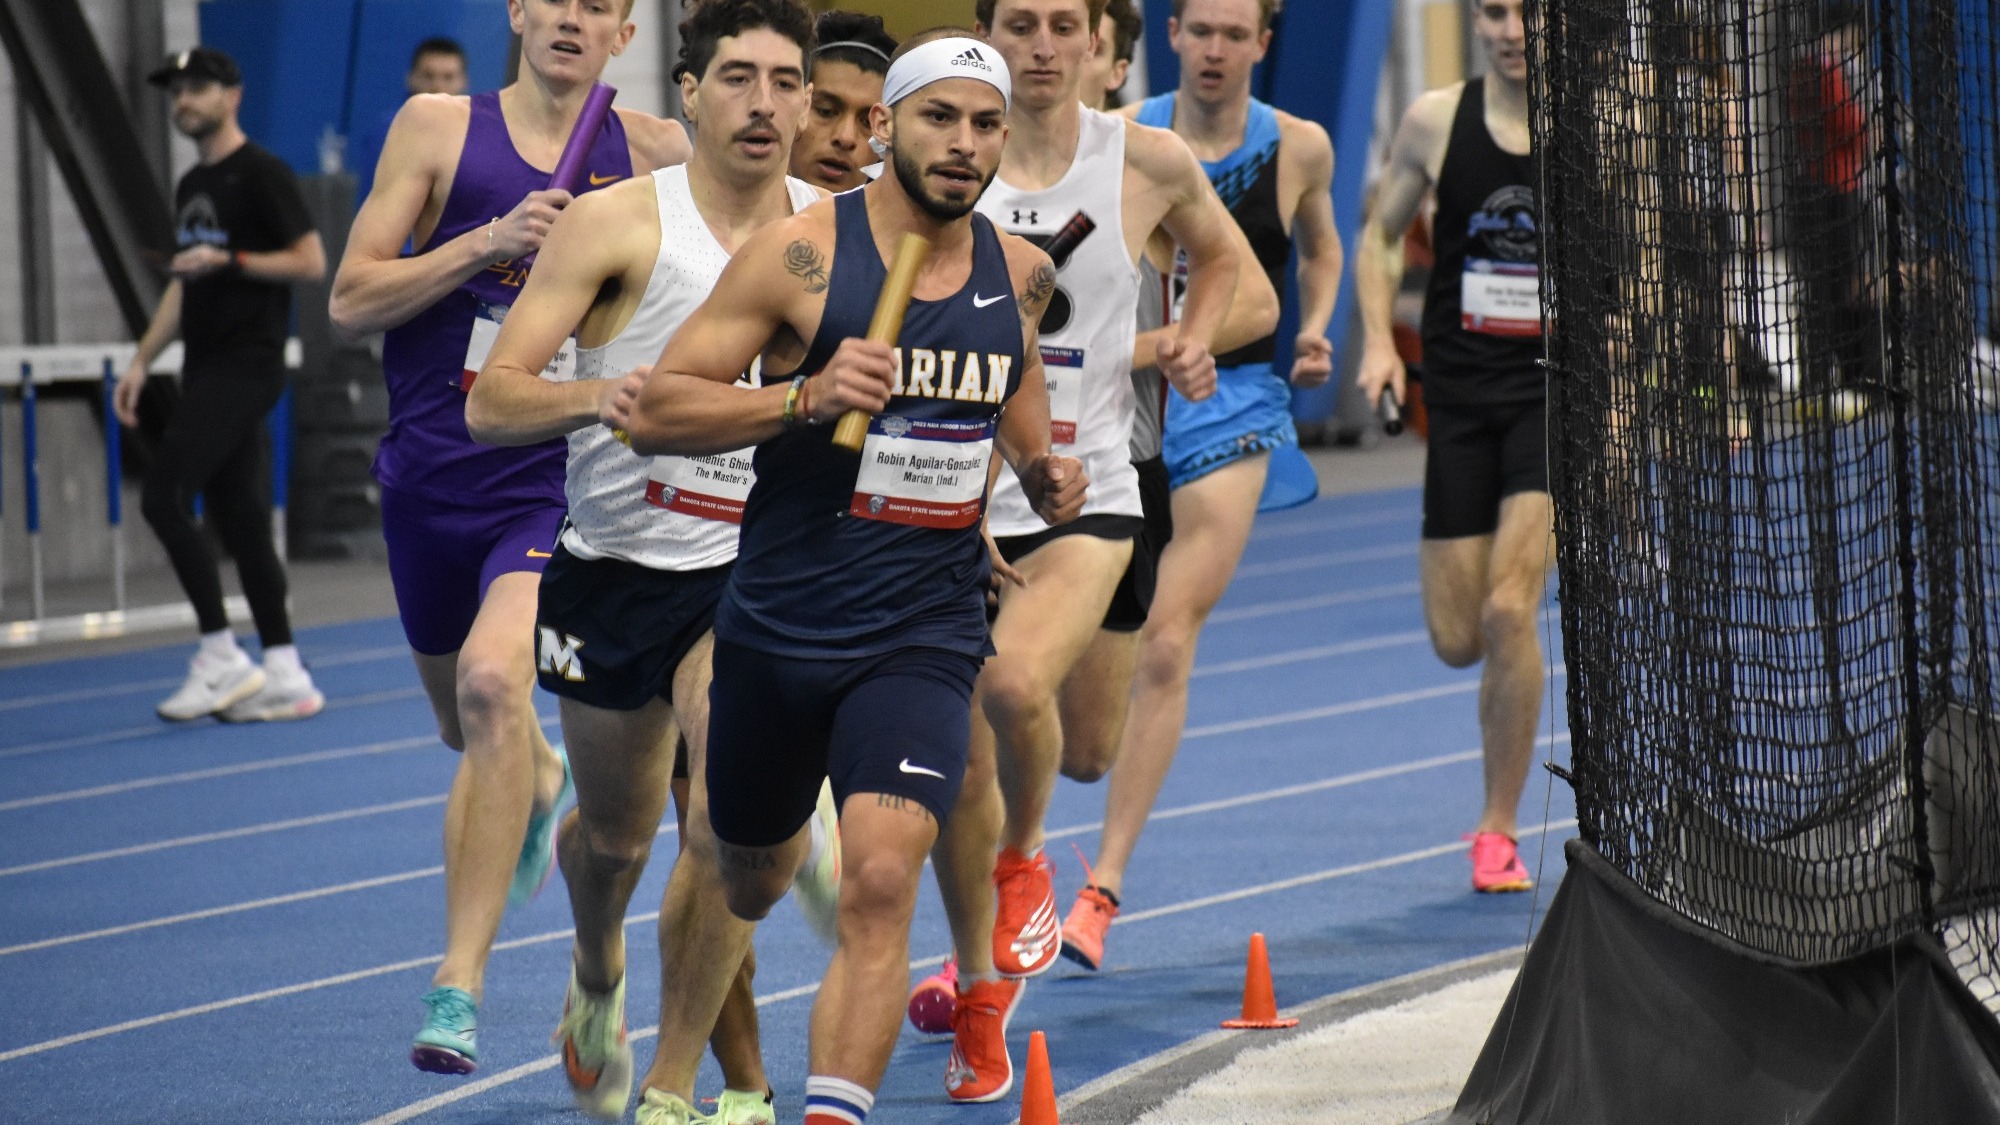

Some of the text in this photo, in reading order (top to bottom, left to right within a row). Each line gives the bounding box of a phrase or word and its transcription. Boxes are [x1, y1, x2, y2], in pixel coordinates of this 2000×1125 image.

[951, 58, 992, 72] adidas
[890, 347, 1012, 404] ARIAN
[684, 454, 726, 467] omenic
[877, 451, 982, 471] Robin Aguilar-Gonzalez
[695, 466, 748, 485] The Master's
[903, 471, 959, 487] Marian (Ind.)
[680, 496, 744, 514] DAKOTA STATE UNIVERSIT
[888, 503, 911, 512] DAKOTA
[911, 506, 928, 514] STATE
[928, 508, 959, 516] UNIVERSITY
[538, 625, 586, 681] M
